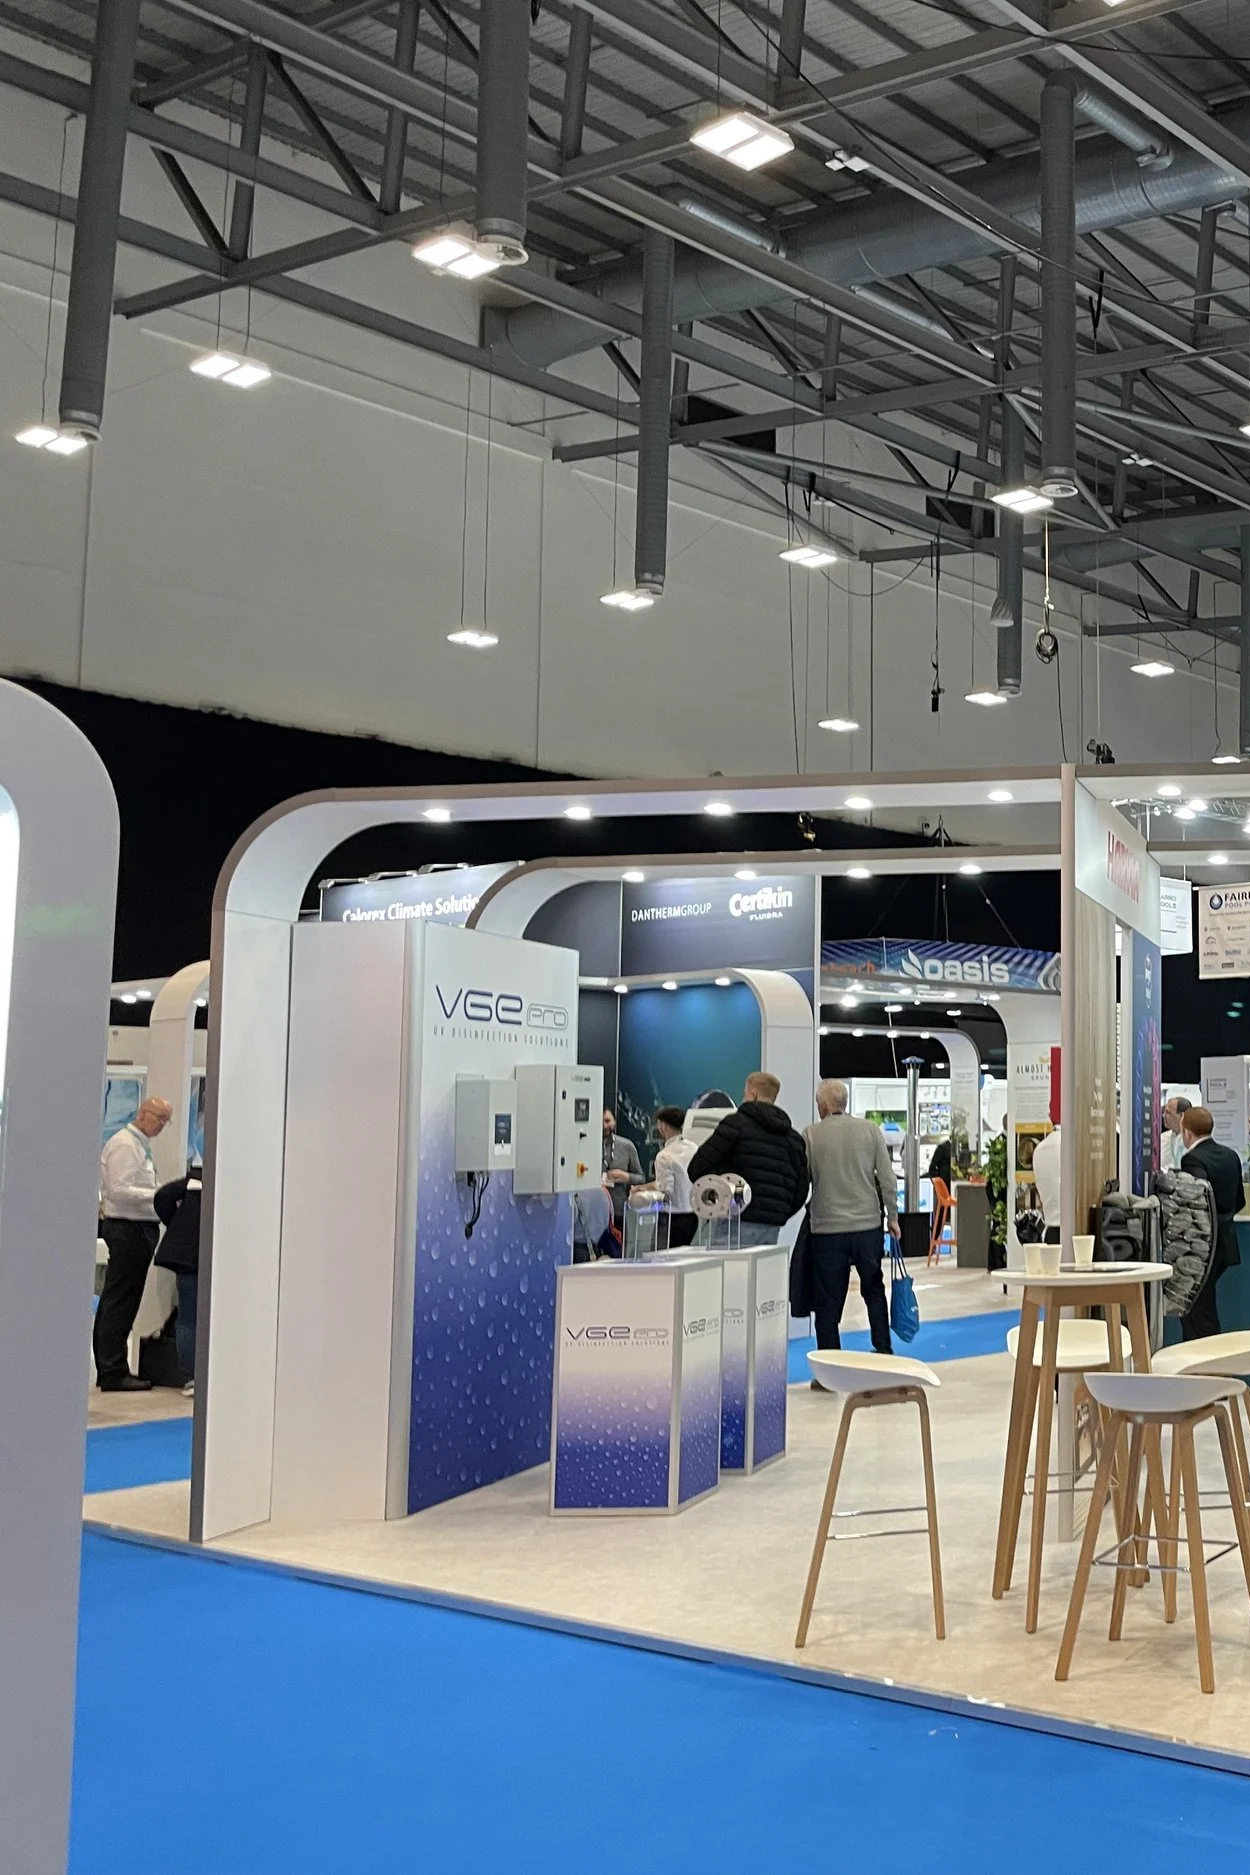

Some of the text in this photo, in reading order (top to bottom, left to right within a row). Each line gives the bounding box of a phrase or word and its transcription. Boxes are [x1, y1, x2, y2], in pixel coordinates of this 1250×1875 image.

[387, 900, 434, 921] Climate
[729, 885, 793, 918] Certikin
[631, 902, 712, 923] DANTHERMGROUP
[749, 910, 784, 921] FLUIDRA
[923, 954, 1011, 984] oasis
[1016, 1063, 1043, 1074] ALMOST
